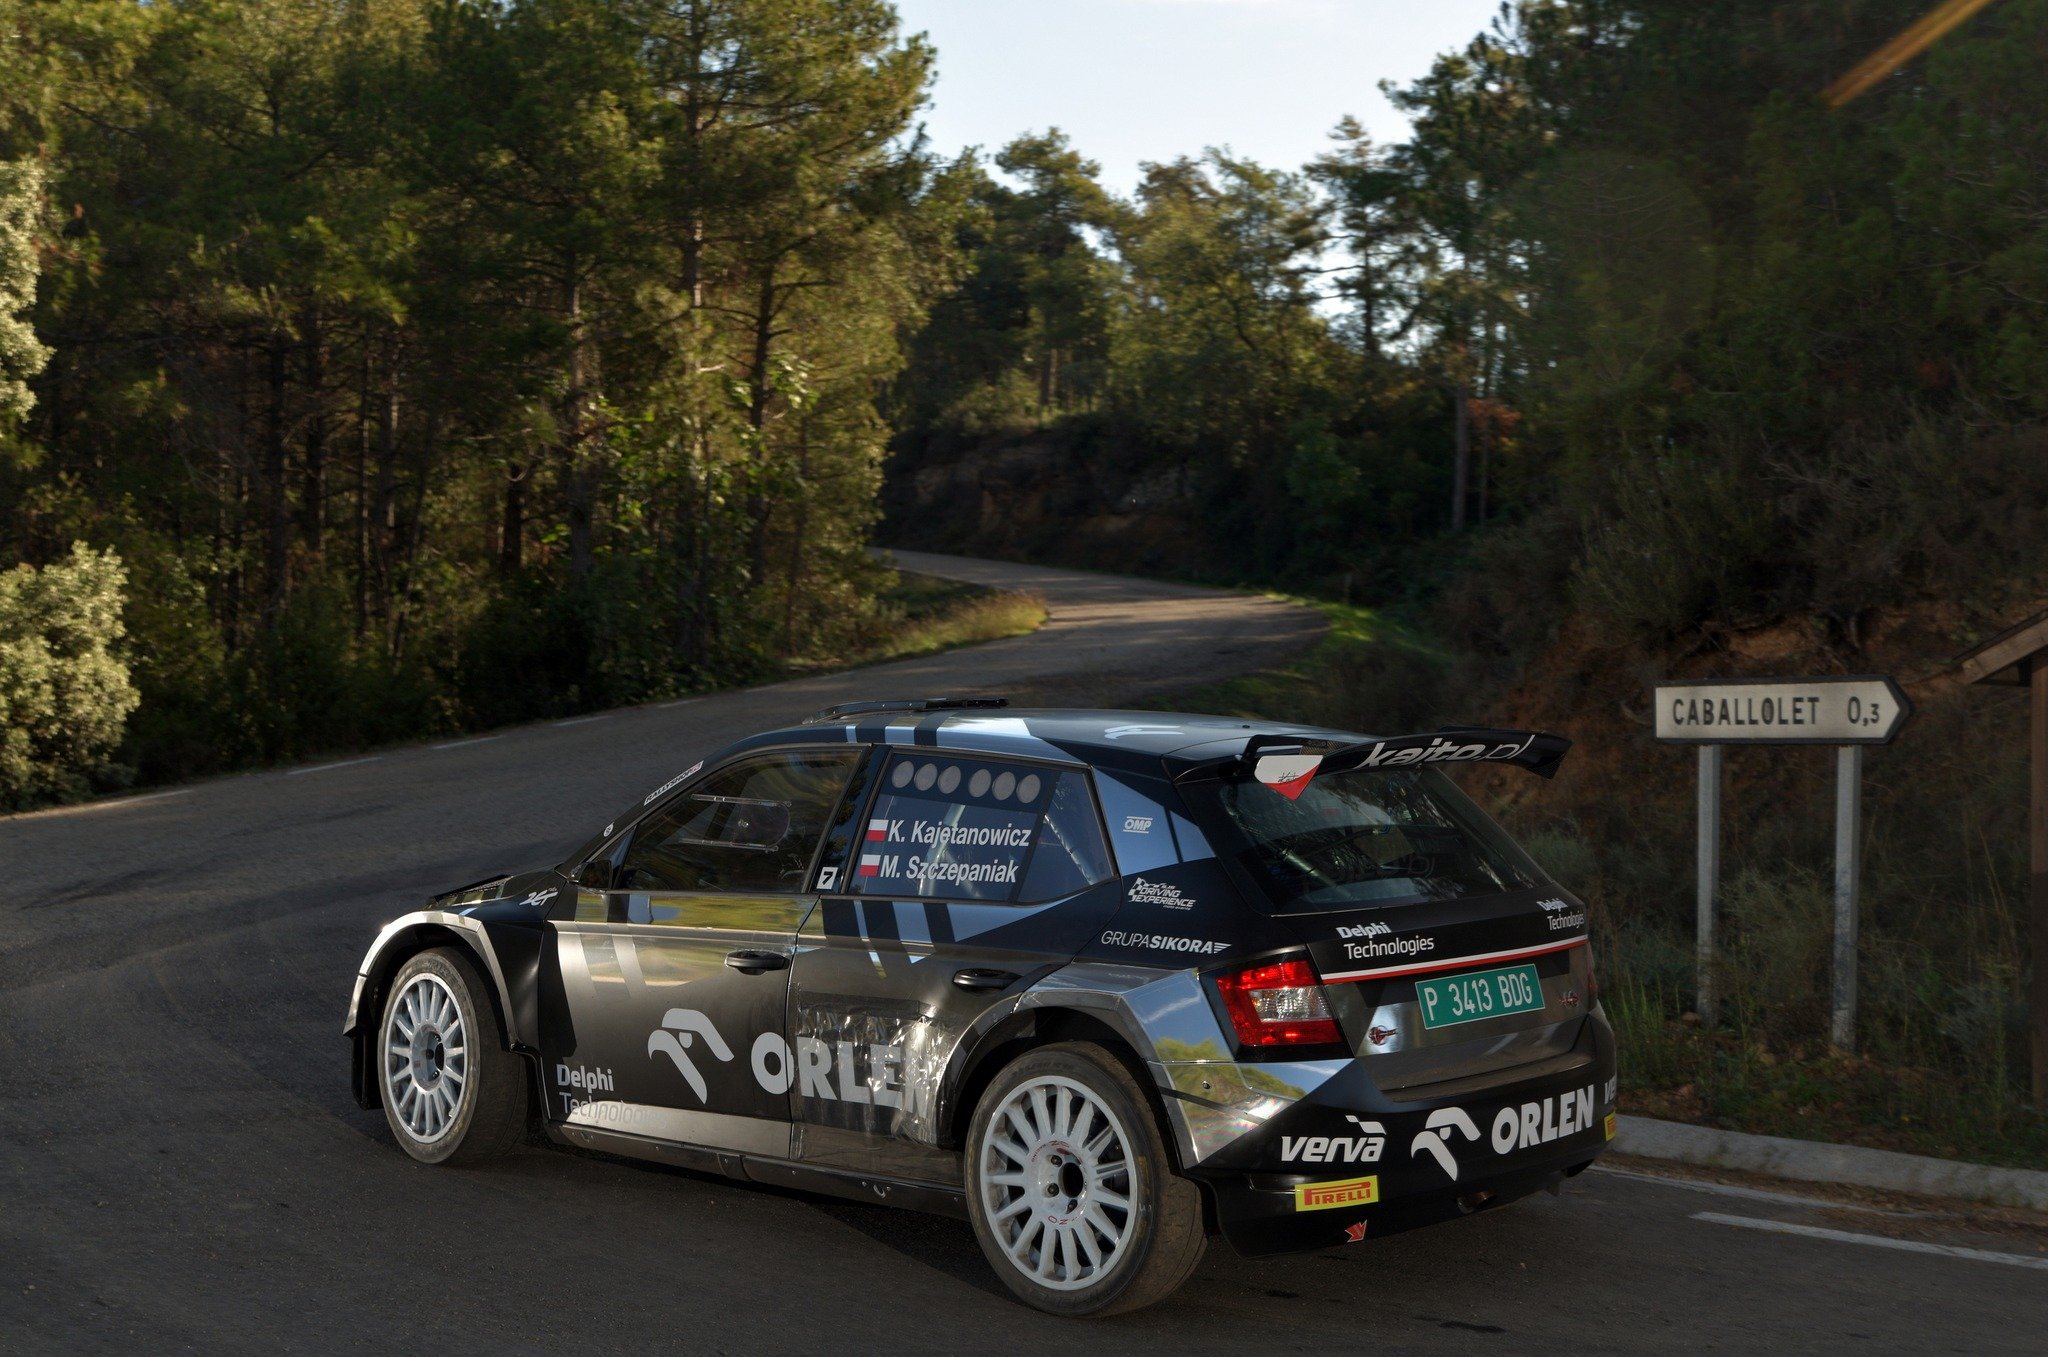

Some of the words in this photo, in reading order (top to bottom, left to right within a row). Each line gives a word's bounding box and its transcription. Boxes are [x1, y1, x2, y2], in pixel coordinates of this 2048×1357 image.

[1672, 697, 1820, 726] CABALLOLET
[1847, 696, 1881, 727] 0,3
[887, 820, 905, 843] K.
[911, 820, 1032, 848] Kajetanowicz
[1124, 818, 1152, 831] OMP
[823, 871, 834, 886] 7
[880, 855, 900, 878] M.
[906, 855, 1019, 886] Szczepaniak
[1135, 895, 1196, 908] EXPERIENCE
[1140, 887, 1181, 898] DRIVING
[1536, 897, 1569, 912] Delphi
[1336, 921, 1392, 939] Delphi
[1547, 910, 1585, 931] Technologies
[1343, 934, 1435, 960] Technologies
[1424, 987, 1438, 1021] P
[1449, 978, 1493, 1017] 3413
[1498, 972, 1533, 1009] BDG
[556, 1064, 614, 1094] Delphi
[751, 1032, 929, 1119] ORLEN
[1491, 1084, 1595, 1155] ORLEN
[1281, 1135, 1386, 1163] verva
[1303, 1181, 1371, 1206] PIRELLI
